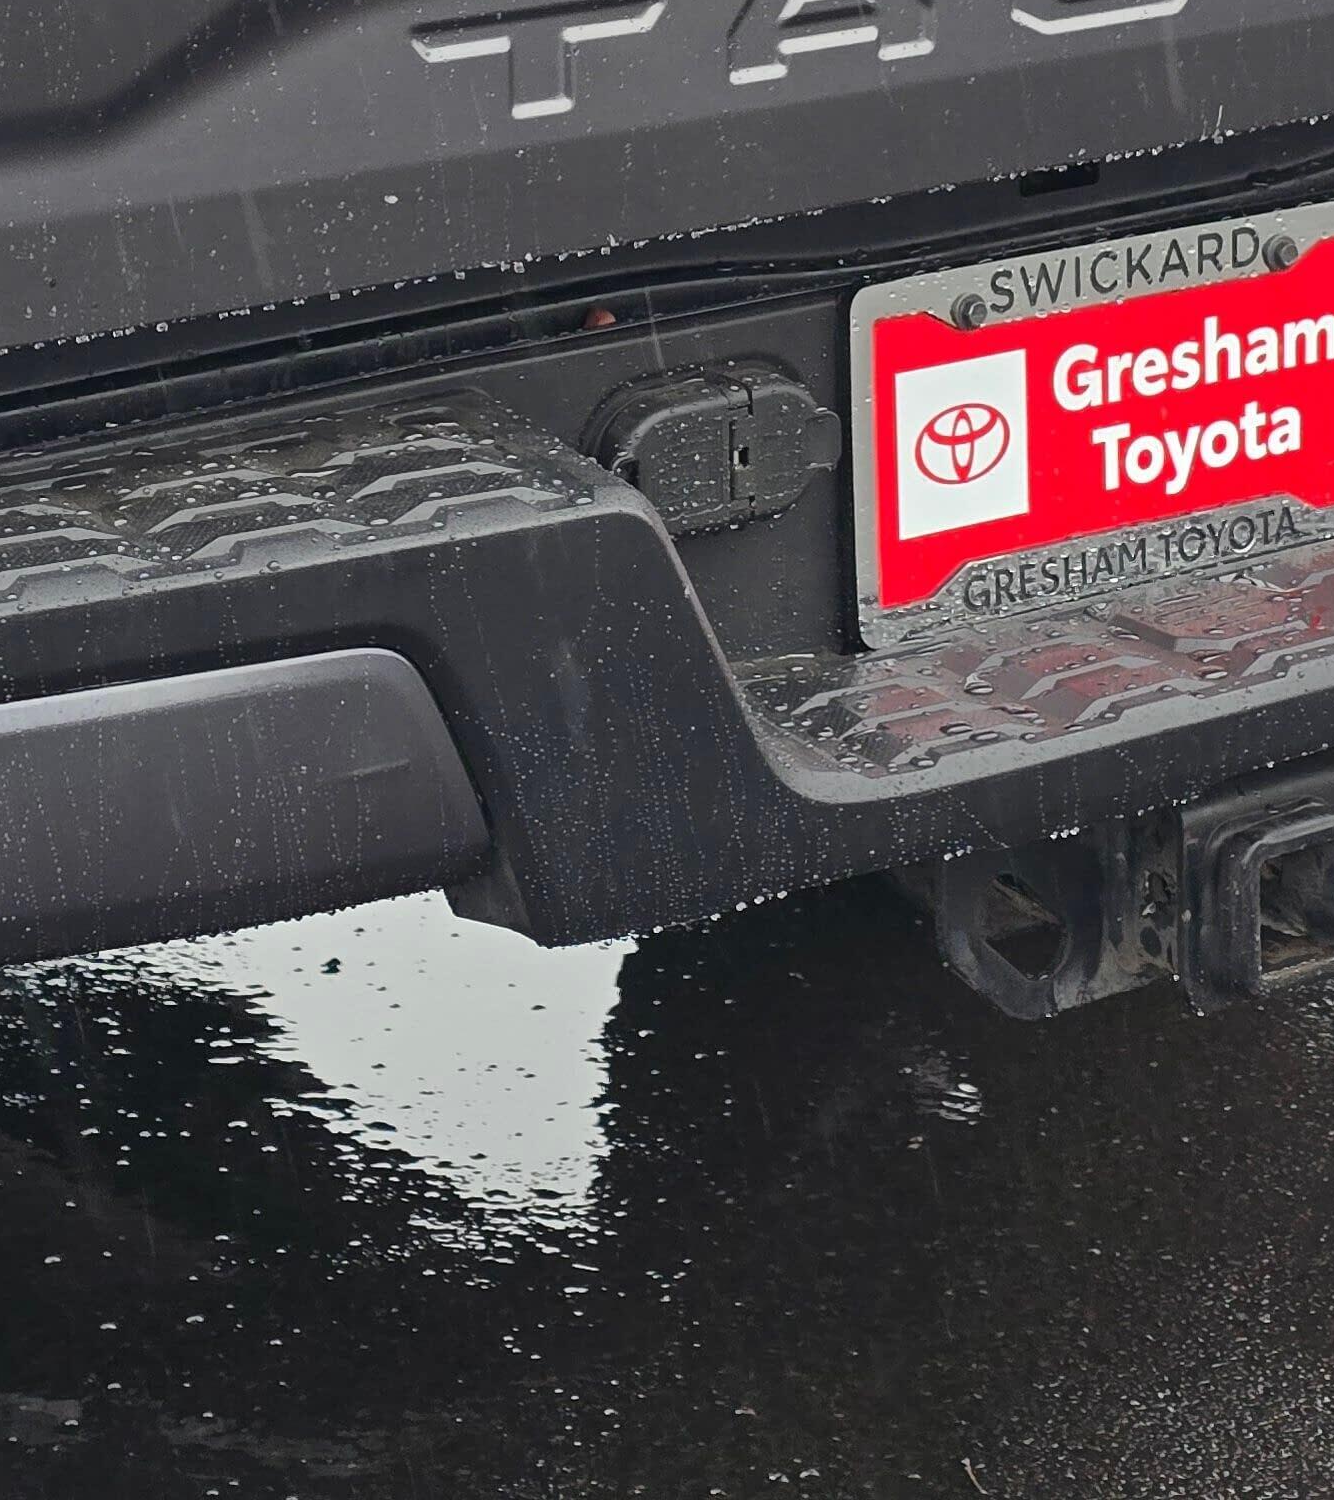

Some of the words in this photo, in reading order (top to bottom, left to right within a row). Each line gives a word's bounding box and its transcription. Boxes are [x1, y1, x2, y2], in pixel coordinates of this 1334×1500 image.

[989, 225, 1261, 314] SWICKARD
[1091, 401, 1303, 495] Toyota
[963, 540, 1149, 614] GRESHAM
[1161, 506, 1305, 563] TOYOTA
